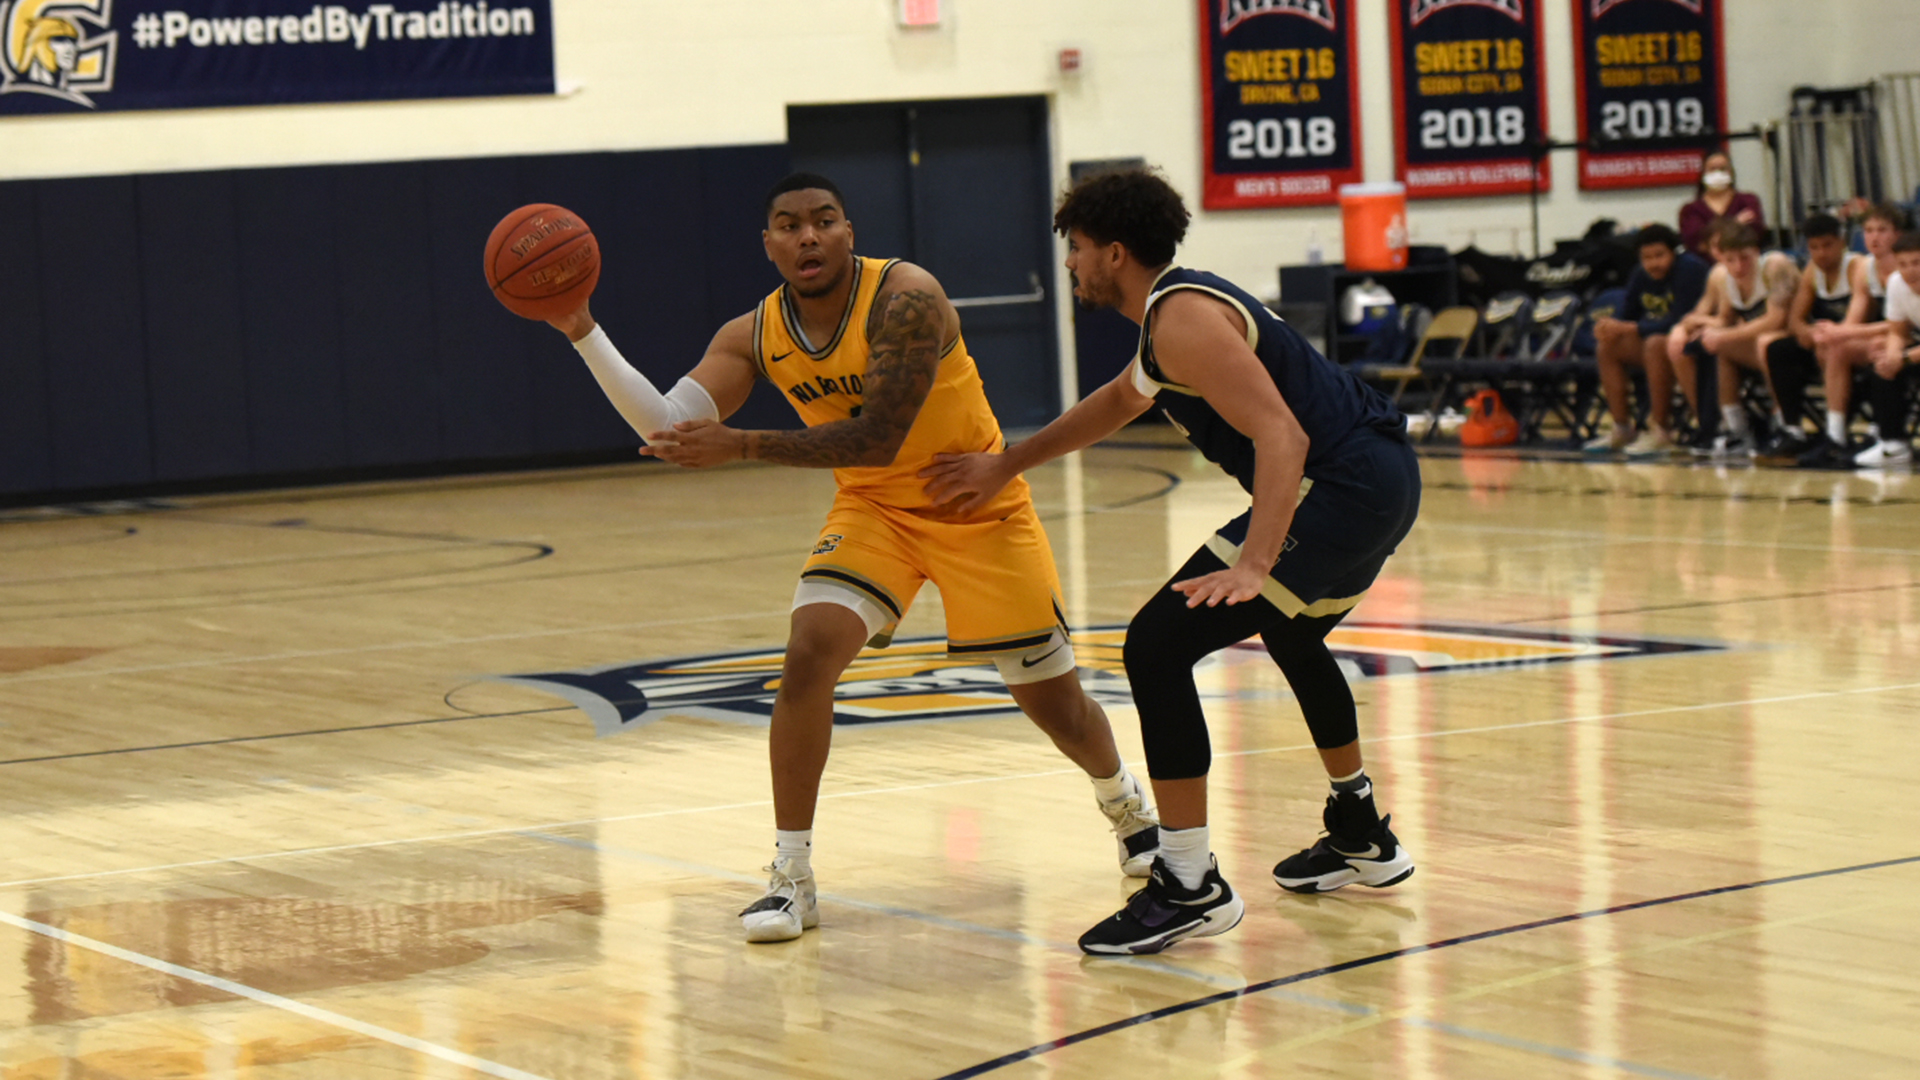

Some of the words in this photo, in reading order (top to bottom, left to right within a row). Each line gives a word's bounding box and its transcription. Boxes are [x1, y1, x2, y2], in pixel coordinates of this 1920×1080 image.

[132, 5, 535, 49] #PoweredByTradition
[1224, 49, 1302, 82] SWEET
[1305, 48, 1336, 80] 16
[1416, 40, 1491, 73] SWEET
[1495, 38, 1524, 70] 16
[1596, 33, 1669, 66] SWEET
[1674, 31, 1702, 62] 16
[1228, 116, 1336, 160] 2018
[1420, 106, 1525, 149] 2018
[1602, 98, 1704, 140] 2019
[788, 374, 864, 405] WARRIO
